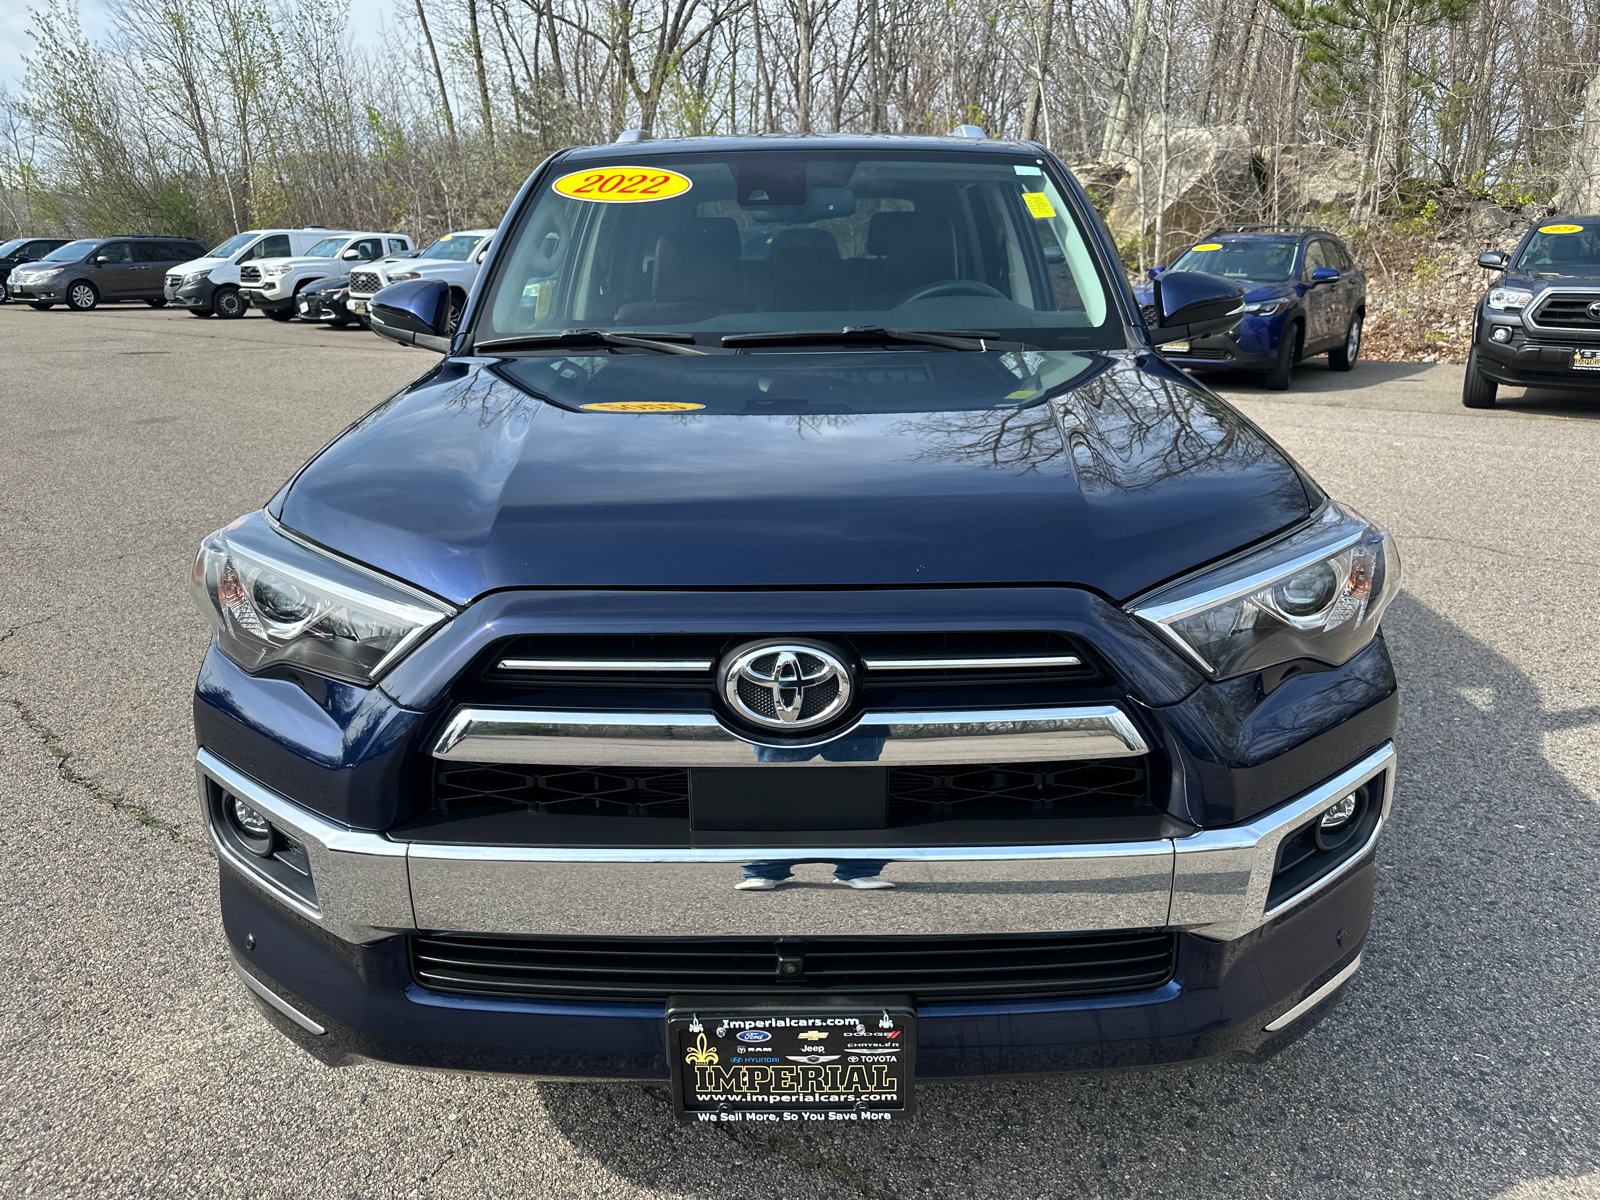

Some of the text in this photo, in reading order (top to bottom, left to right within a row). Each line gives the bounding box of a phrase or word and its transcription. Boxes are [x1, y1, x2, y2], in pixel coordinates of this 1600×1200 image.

[572, 174, 671, 194] 2022
[723, 1018, 859, 1030] Imperialcars.com
[744, 1032, 763, 1040] Ford
[802, 1045, 824, 1054] Jeep
[695, 1065, 897, 1092] IMPERIAL
[696, 1093, 897, 1103] www.imperialcars.com
[698, 1112, 891, 1122] We Sell More, So You Save More
